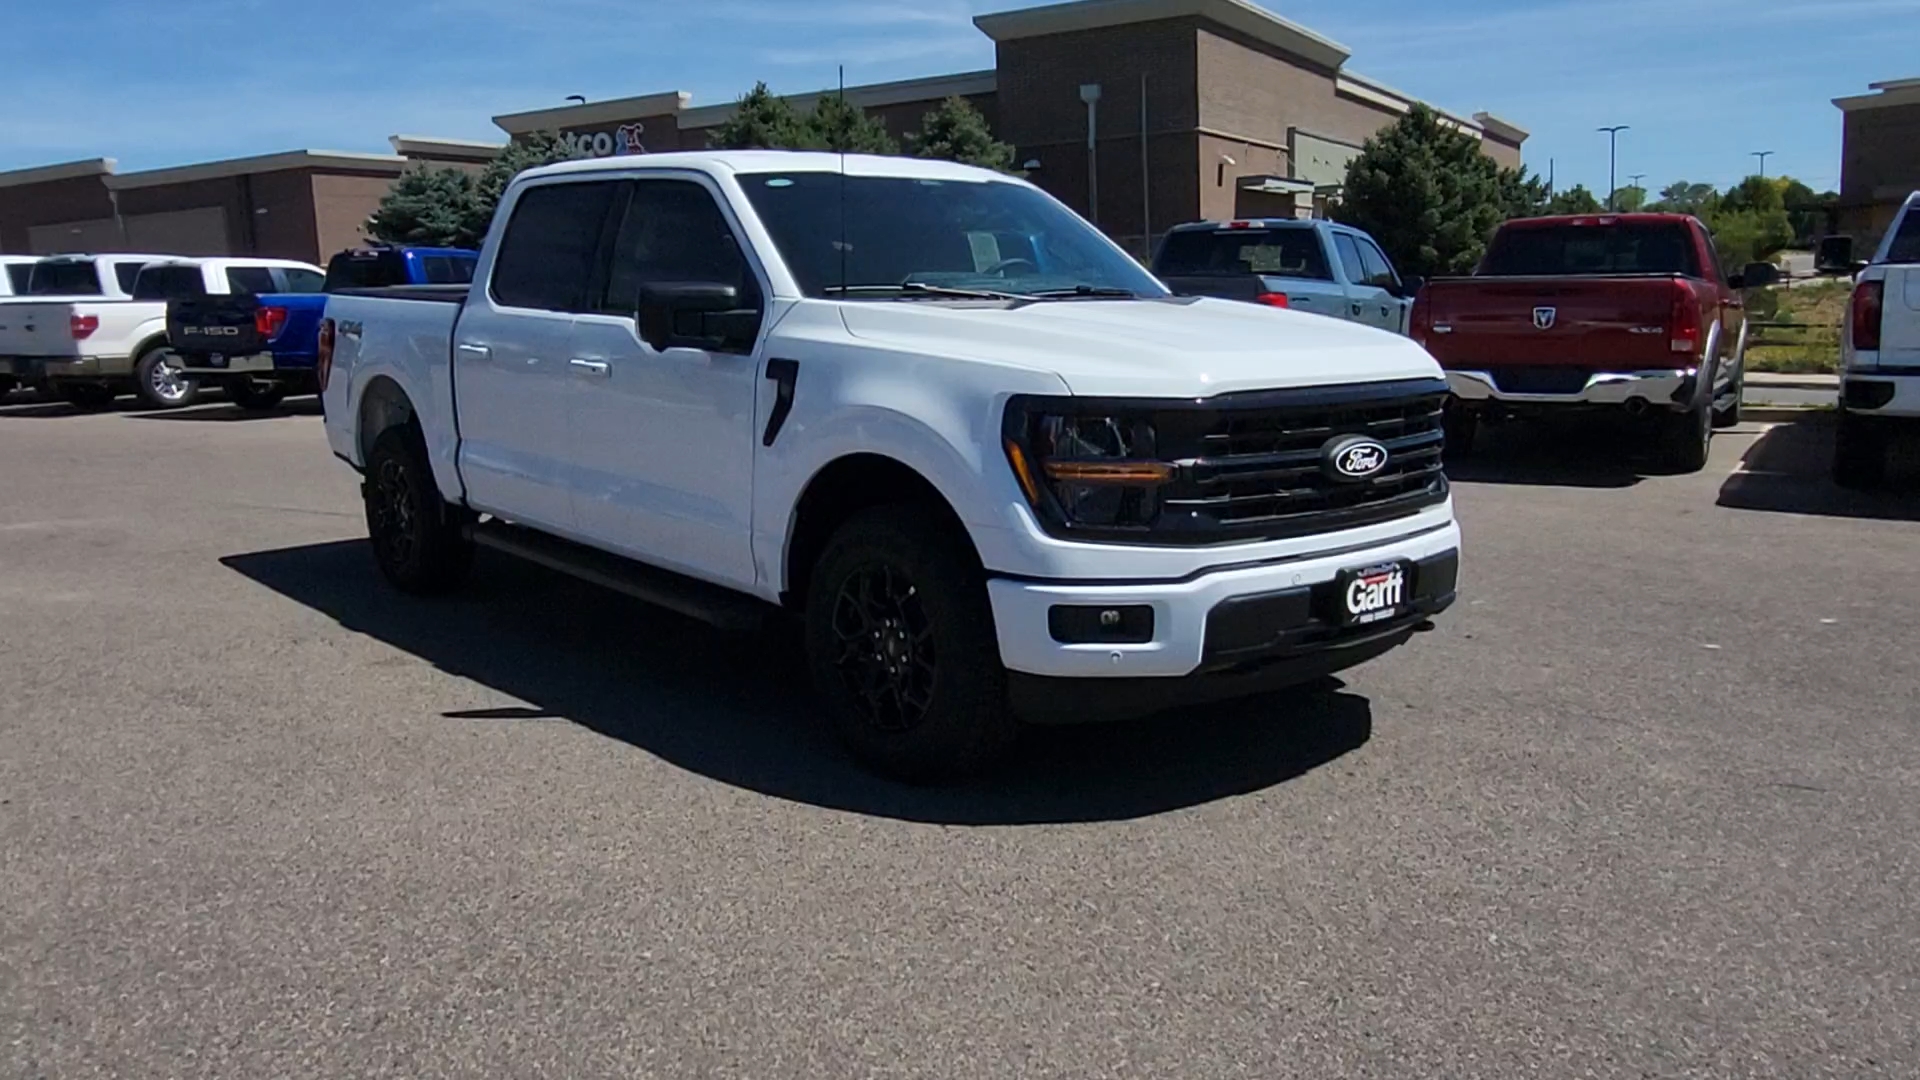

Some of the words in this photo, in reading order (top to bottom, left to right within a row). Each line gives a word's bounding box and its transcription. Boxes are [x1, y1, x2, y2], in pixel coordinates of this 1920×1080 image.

[566, 131, 613, 157] tco
[183, 326, 239, 336] F-150
[1346, 447, 1379, 471] Ford
[1346, 571, 1403, 615] Garff
